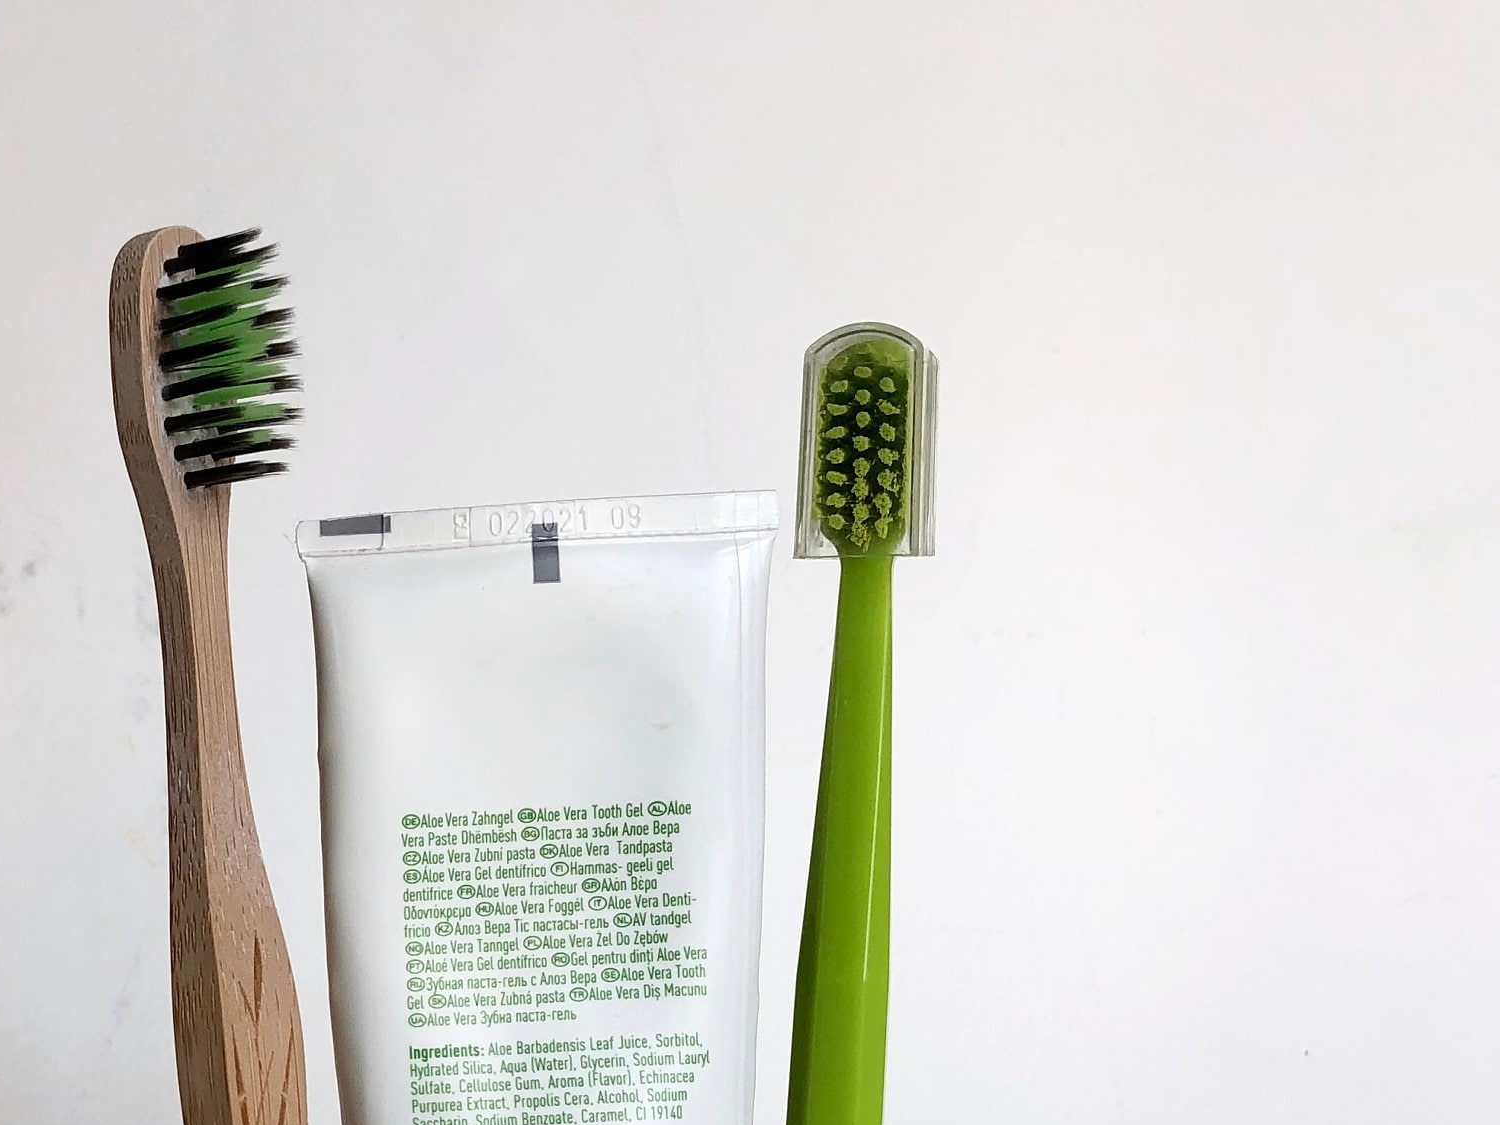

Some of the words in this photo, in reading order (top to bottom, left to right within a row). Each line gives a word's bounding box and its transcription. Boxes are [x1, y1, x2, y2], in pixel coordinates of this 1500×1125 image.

[445, 812, 468, 827] Vera
[472, 809, 514, 828] Zahngel
[564, 806, 587, 820] Vera
[592, 804, 622, 819] Tooth
[626, 802, 644, 818] Gel
[401, 834, 424, 848] Vera
[428, 832, 457, 846] Paste
[576, 828, 588, 838] за
[592, 823, 618, 838] зъби
[622, 822, 649, 836] Алое
[653, 820, 680, 838] Вера
[447, 849, 470, 864] Vera
[507, 847, 535, 864] pasta
[586, 842, 609, 856] Vera
[616, 840, 672, 857] Tandpasta
[448, 868, 471, 881] Vera
[475, 866, 492, 880] Gel
[626, 858, 653, 876] geeli
[656, 856, 674, 875] gel
[403, 886, 453, 902] dentifrice
[502, 883, 526, 897] Vera
[530, 881, 578, 896] fraicheur
[521, 900, 544, 914] Vera
[634, 894, 658, 908] Vera
[404, 924, 430, 938] fricio
[484, 920, 510, 936] Вера
[650, 910, 692, 928] tandgel
[450, 940, 473, 954] Vera
[477, 937, 520, 955] Tanngel
[569, 934, 592, 948] Vera
[616, 932, 630, 946] Do
[450, 958, 473, 972] Vera
[477, 956, 494, 971] Gel
[592, 951, 626, 968] pentru
[657, 947, 681, 962] Aloe
[684, 946, 707, 960] Vera
[467, 976, 528, 989] паста-гель
[570, 970, 596, 987] Вера
[647, 966, 672, 980] Vera
[675, 964, 706, 978] Tooth
[407, 995, 424, 1010] Gel
[473, 993, 496, 1006] Vera
[536, 990, 565, 1007] pasta
[615, 986, 640, 999] Vera
[664, 982, 707, 997] Macunu
[453, 1012, 476, 1025] Vera
[480, 1010, 512, 1027] Зубна
[516, 1010, 576, 1022] паста-гель
[410, 1044, 484, 1062] Ingredients:
[488, 1042, 512, 1056] Aloe
[516, 1038, 586, 1054] Barbadensis
[590, 1036, 614, 1051] Leaf
[410, 1062, 458, 1081] Hydrated
[500, 1060, 527, 1076] Aqua
[633, 1052, 674, 1066] Sodium
[678, 1050, 710, 1068] Lauryl
[459, 1078, 511, 1093] Cellulose
[548, 1075, 584, 1089] Aroma
[639, 1070, 694, 1084] Echinacea
[412, 1099, 462, 1116] Purpurea
[514, 1093, 560, 1111] Propolis
[647, 1088, 687, 1102] Sodium
[651, 1105, 682, 1120] 19140
